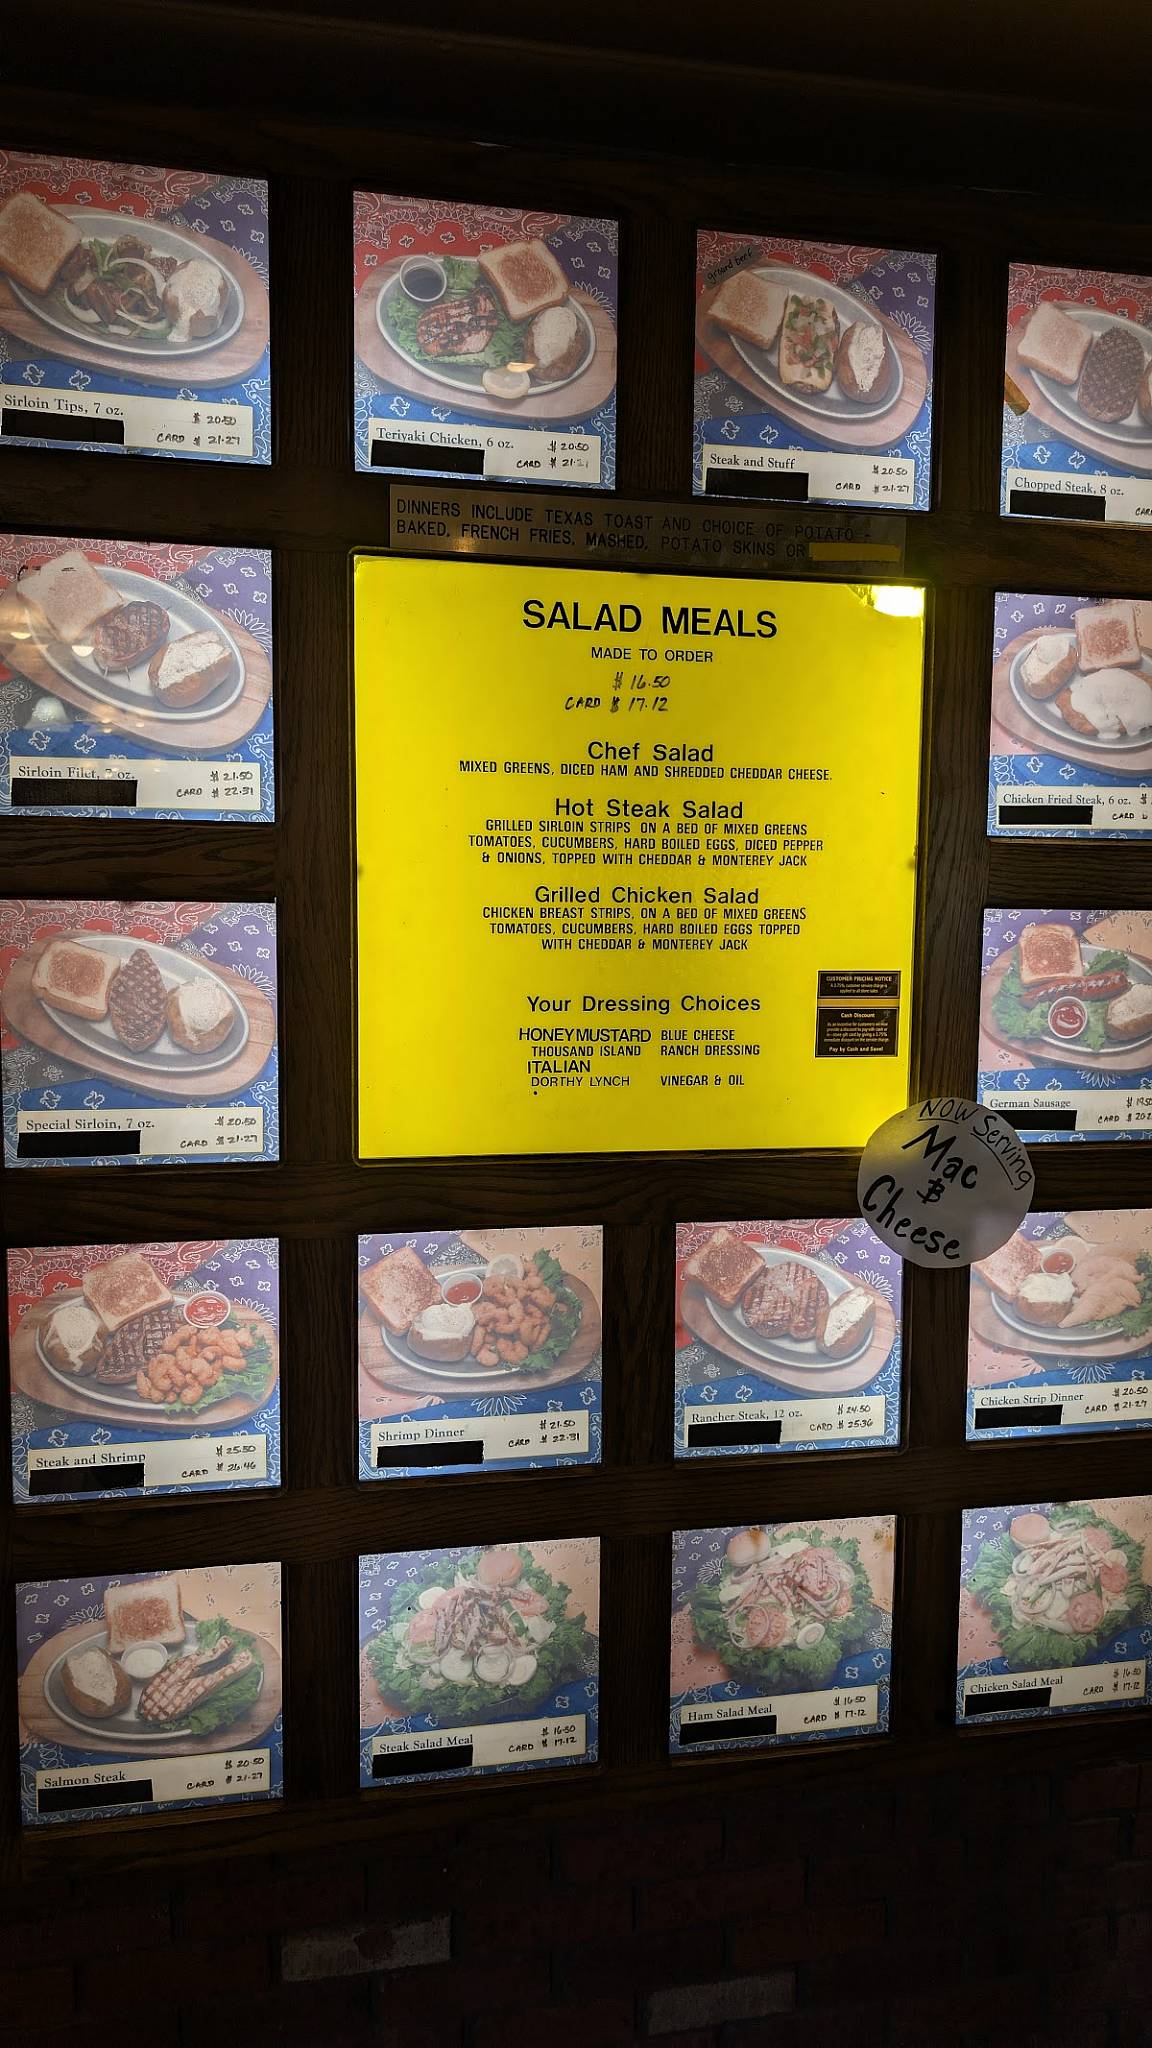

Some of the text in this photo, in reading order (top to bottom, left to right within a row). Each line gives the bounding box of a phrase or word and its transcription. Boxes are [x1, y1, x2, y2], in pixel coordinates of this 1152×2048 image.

[5, 394, 123, 415] Sirloin Tips, 7 oz.
[376, 428, 425, 441] Teriyaki
[430, 432, 481, 448] Chicken,
[487, 438, 493, 446] 6
[710, 454, 795, 469] Steak and Stuff
[1015, 477, 1061, 490] Chopped
[1065, 481, 1096, 494] Steak,
[1100, 485, 1106, 494] 8
[397, 499, 854, 541] DINNERS INCLUDE TEXAS TOAST AND CHOICE OF POTATO
[462, 523, 519, 542] FRENCH
[661, 536, 722, 554] POTATO
[733, 540, 776, 556] SKINS
[786, 543, 807, 557] OR
[523, 600, 777, 638] SALAD MEALS
[592, 647, 713, 662] MADE TO ORDER
[631, 675, 670, 689] 16.50
[565, 697, 600, 710] CARD
[629, 697, 667, 711] 17.12
[588, 742, 713, 762] Chef Salad
[19, 766, 62, 777] Sirloin
[67, 766, 100, 780] Filet,
[460, 760, 832, 780] MIXED GREENS, DICED HAM AND SHREDDED CHEDDAR CHEESE.
[1003, 794, 1043, 804] Chicken
[1048, 794, 1072, 804] Fried
[1076, 795, 1104, 806] Steak,
[1109, 796, 1114, 804] 6
[556, 798, 742, 818] Hot Steak Salad
[469, 835, 823, 851] TOMATOES, CUCUMBERS, HARD BOILED EGGS, DICED PEPPER
[482, 852, 807, 866] & ONIONS, TOPPED WITH CHEDDAR & MONTEREY JACK
[535, 886, 758, 904] Grilled Chicken Salad
[527, 995, 760, 1014] Your Dressing Choices
[661, 1030, 735, 1040] BLUE CHEESE
[532, 1045, 641, 1057] THOUSAND ISLAND
[661, 1045, 760, 1056] RANCH DRESSING
[528, 1060, 590, 1074] ITALIAN
[532, 1076, 629, 1086] DORTHY LYNCH
[661, 1075, 744, 1086] VINEGAR & OIL
[990, 1099, 1070, 1108] German Sausage
[27, 1119, 70, 1131] Special
[75, 1118, 120, 1130] Sirloin,
[126, 1118, 132, 1128] 7
[227, 1118, 256, 1126] 20.50
[180, 1140, 207, 1148] CARD
[227, 1135, 257, 1144] 21.27
[919, 1098, 1032, 1191] NOW Serving
[901, 1124, 978, 1189] Mac
[862, 1174, 960, 1260] Cheese
[1122, 1386, 1148, 1396] 20.50
[981, 1393, 1084, 1406] Chicken Strip Dinner
[1085, 1405, 1107, 1414] CARD
[1122, 1400, 1147, 1408] 21.27
[693, 1412, 735, 1422] Rancher
[739, 1410, 768, 1420] Steak,
[774, 1409, 784, 1418] 12
[550, 1420, 575, 1429] 21.50
[379, 1429, 464, 1441] Shrimp Dinner
[508, 1439, 530, 1447] CARD
[553, 1433, 579, 1442] 22.31
[36, 1453, 145, 1468] Steak and Shrimp
[970, 1676, 1063, 1693] Chicken Salad Meal
[688, 1704, 772, 1721] Ham Salad Meal
[380, 1734, 472, 1752] Steak Salad Meal
[45, 1771, 126, 1787] Salmon Steak
